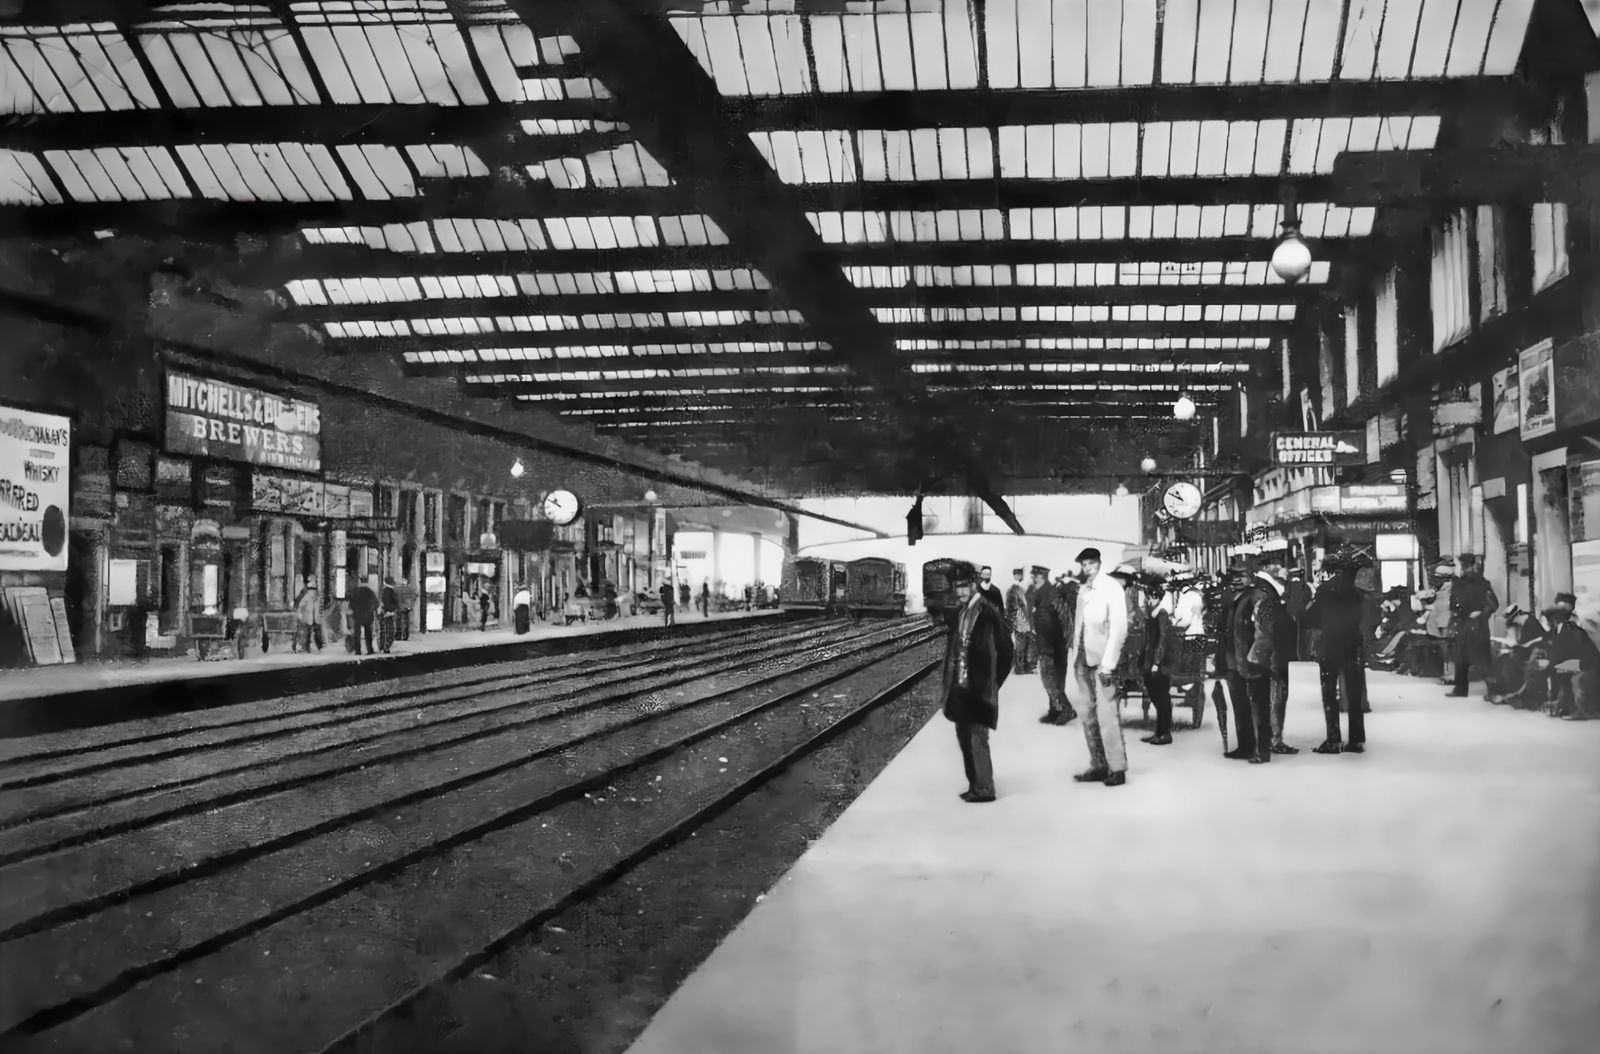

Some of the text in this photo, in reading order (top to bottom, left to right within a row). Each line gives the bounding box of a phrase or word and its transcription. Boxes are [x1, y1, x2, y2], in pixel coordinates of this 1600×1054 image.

[169, 375, 253, 421] MITCHELLS
[193, 415, 303, 454] BREWERS
[24, 460, 59, 482] WHISKY
